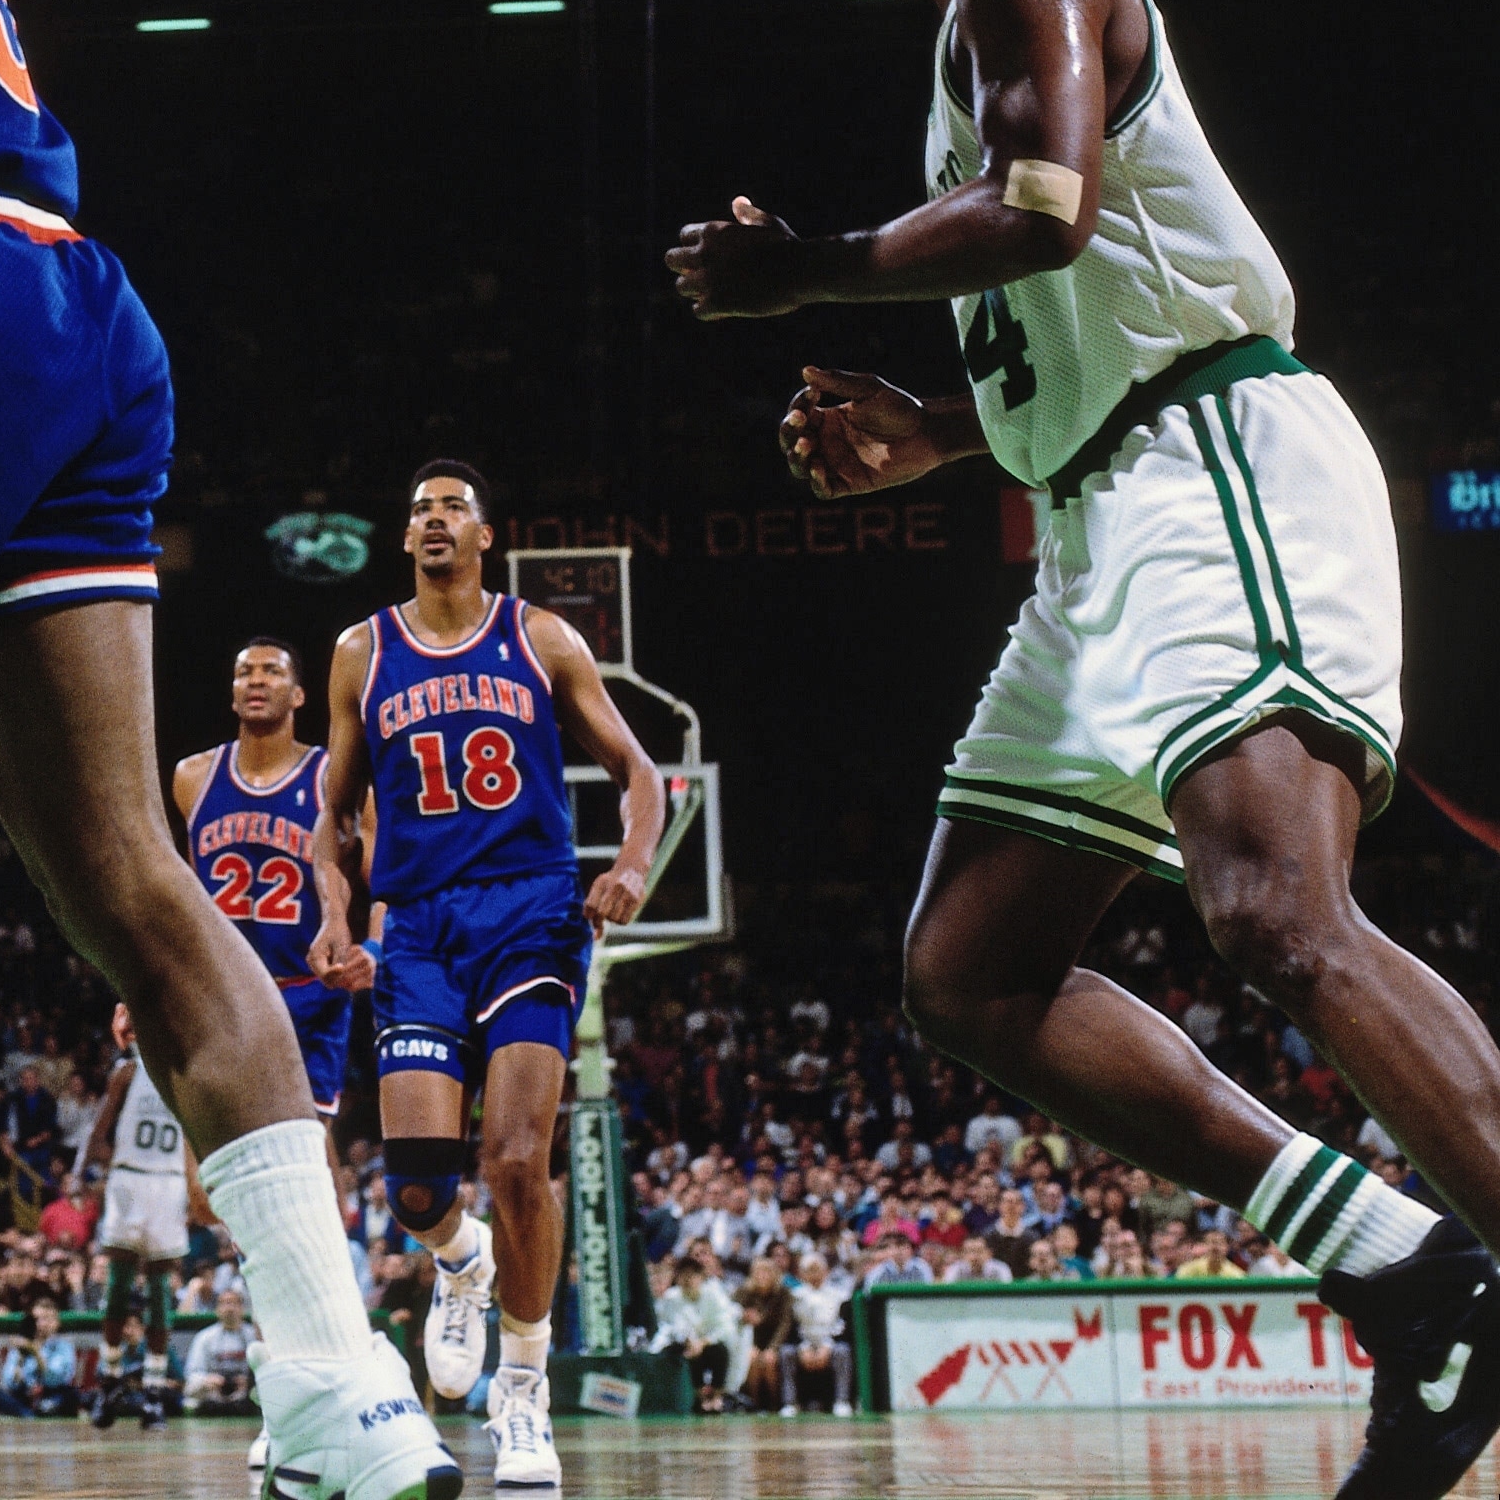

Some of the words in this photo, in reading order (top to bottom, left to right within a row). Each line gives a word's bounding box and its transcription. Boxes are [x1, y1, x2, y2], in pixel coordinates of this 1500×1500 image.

[705, 502, 948, 557] DEERE
[378, 673, 535, 740] CLEVELAND
[409, 725, 522, 816] 18
[209, 852, 304, 926] 22
[391, 1039, 449, 1062] CAVS
[135, 1119, 178, 1154] 00
[1138, 1302, 1264, 1372] FOX
